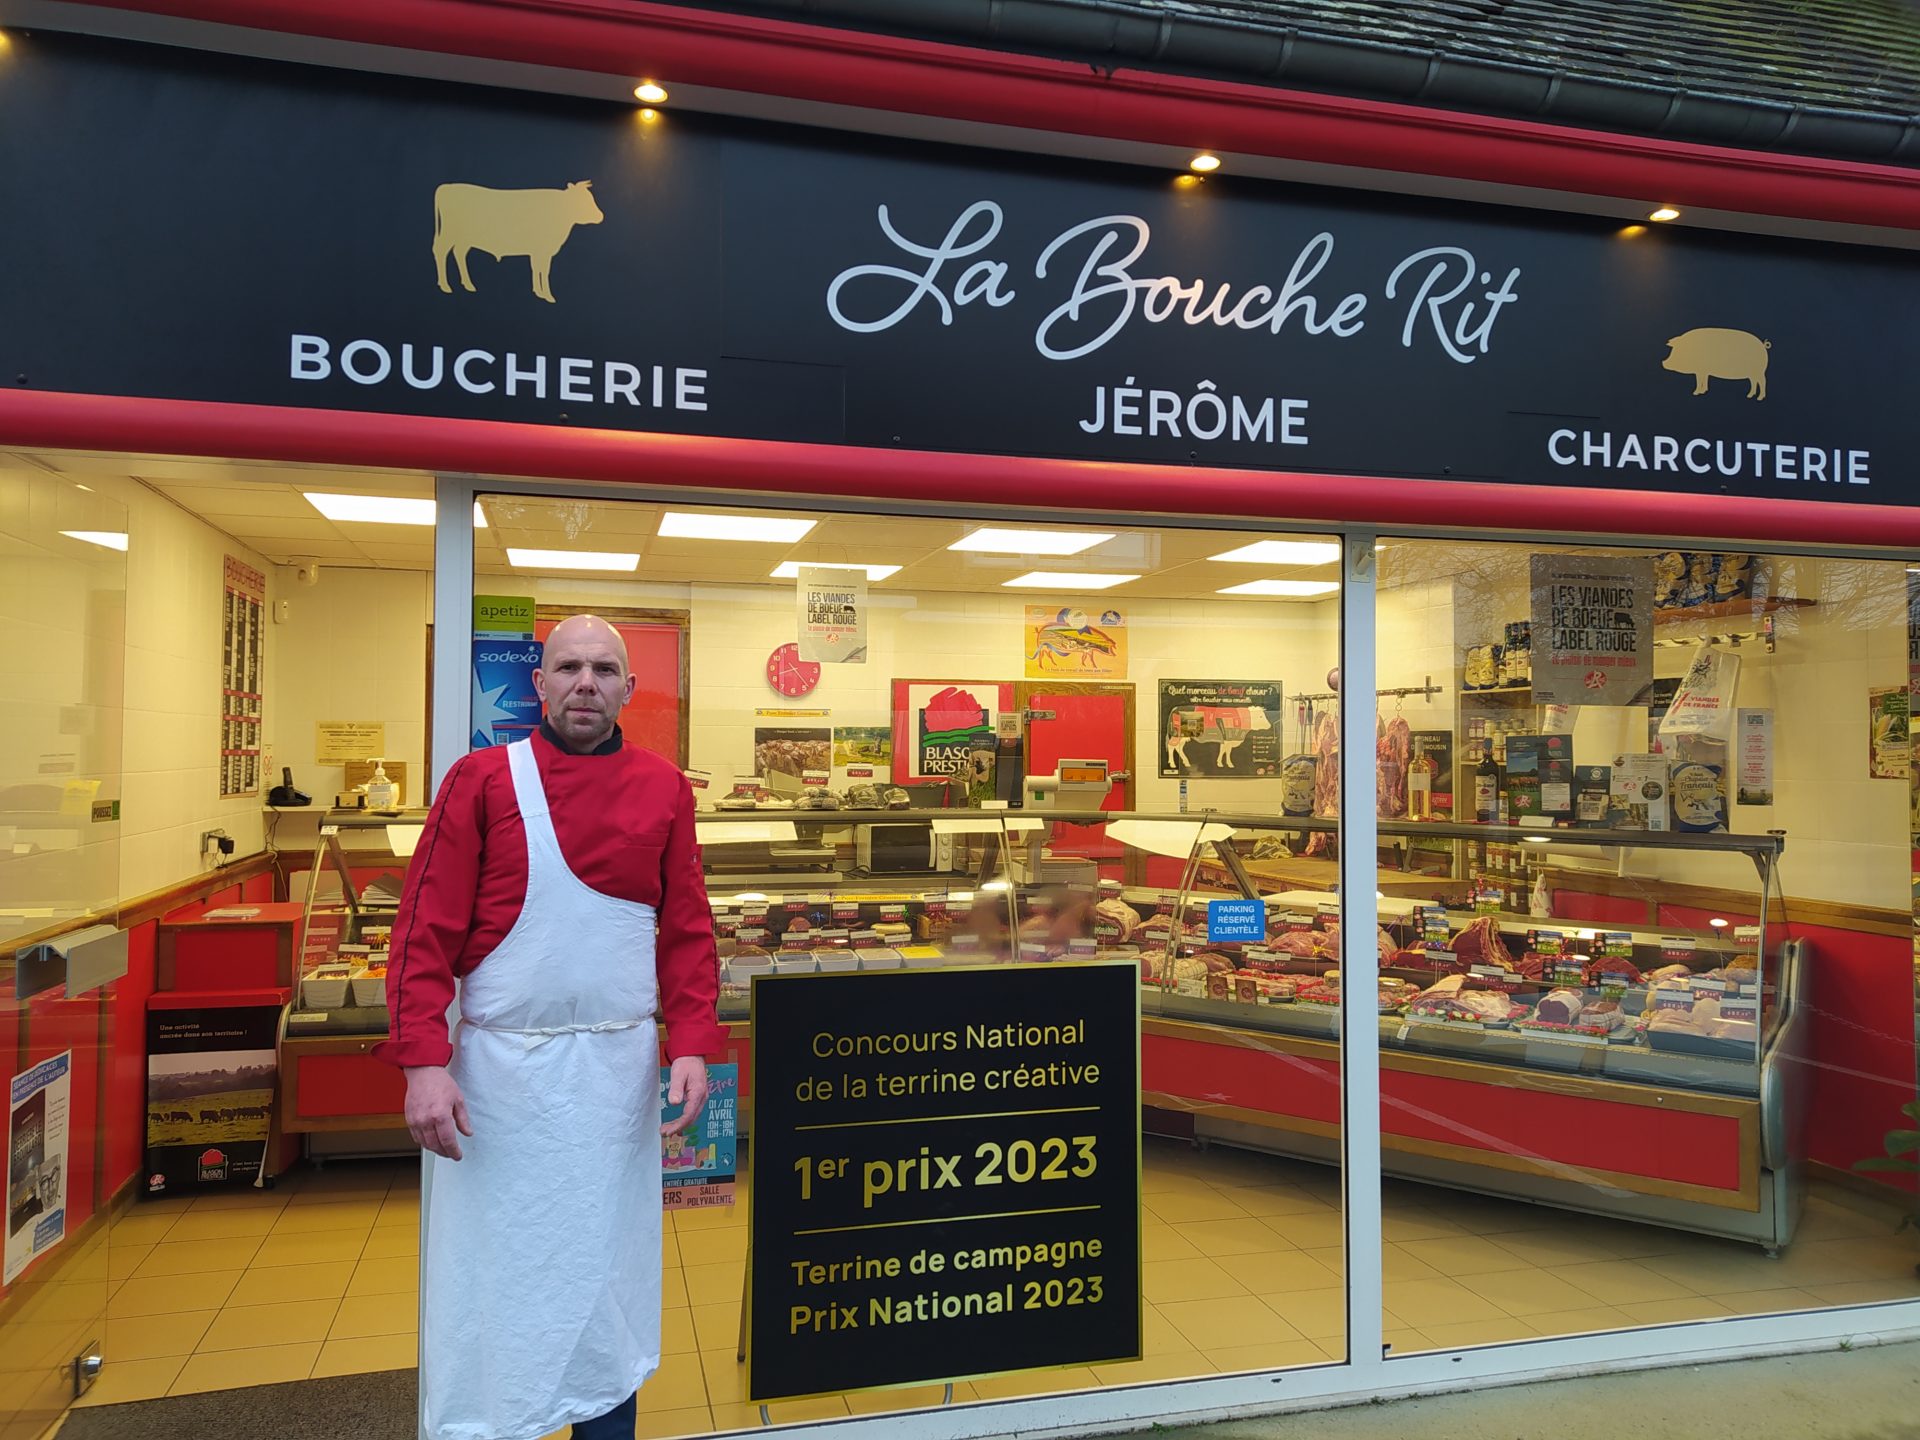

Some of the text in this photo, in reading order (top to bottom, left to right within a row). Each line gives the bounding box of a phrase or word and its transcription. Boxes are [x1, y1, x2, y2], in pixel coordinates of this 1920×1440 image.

[827, 200, 1521, 363] La Bouche Rit
[290, 334, 708, 411] BOUCHERIE
[1079, 376, 1309, 445] JÉRÔME
[1548, 429, 1870, 485] CHARCUTERIE
[807, 591, 856, 604] LES VIANDES
[1552, 584, 1634, 609] LES VIANDES
[480, 604, 529, 618] apetiz
[807, 602, 819, 613] DE
[807, 613, 857, 626] LABEL ROUGE
[1552, 606, 1570, 628] DE
[1552, 630, 1637, 652] LABEL ROUGE
[478, 650, 539, 663] sodexo
[1168, 685, 1187, 696] Quel
[1187, 687, 1218, 695] morceau
[1218, 905, 1255, 913] PARKING
[1217, 914, 1256, 924] RÉSERVÉ
[1214, 925, 1259, 934] CLIENTÈLE
[812, 1019, 1084, 1058] Concours National
[795, 1061, 1100, 1101] de la terrine créative
[708, 1109, 734, 1120] AVRIL
[794, 1135, 1097, 1209] 1er prix 2023
[664, 1177, 708, 1188] ENTRÉE GRATUITE
[699, 1185, 720, 1196] SALLE
[687, 1195, 733, 1206] POLYVALENTE
[791, 1238, 1103, 1287] Terrine de campagne
[790, 1275, 1104, 1335] Prix National 2023
